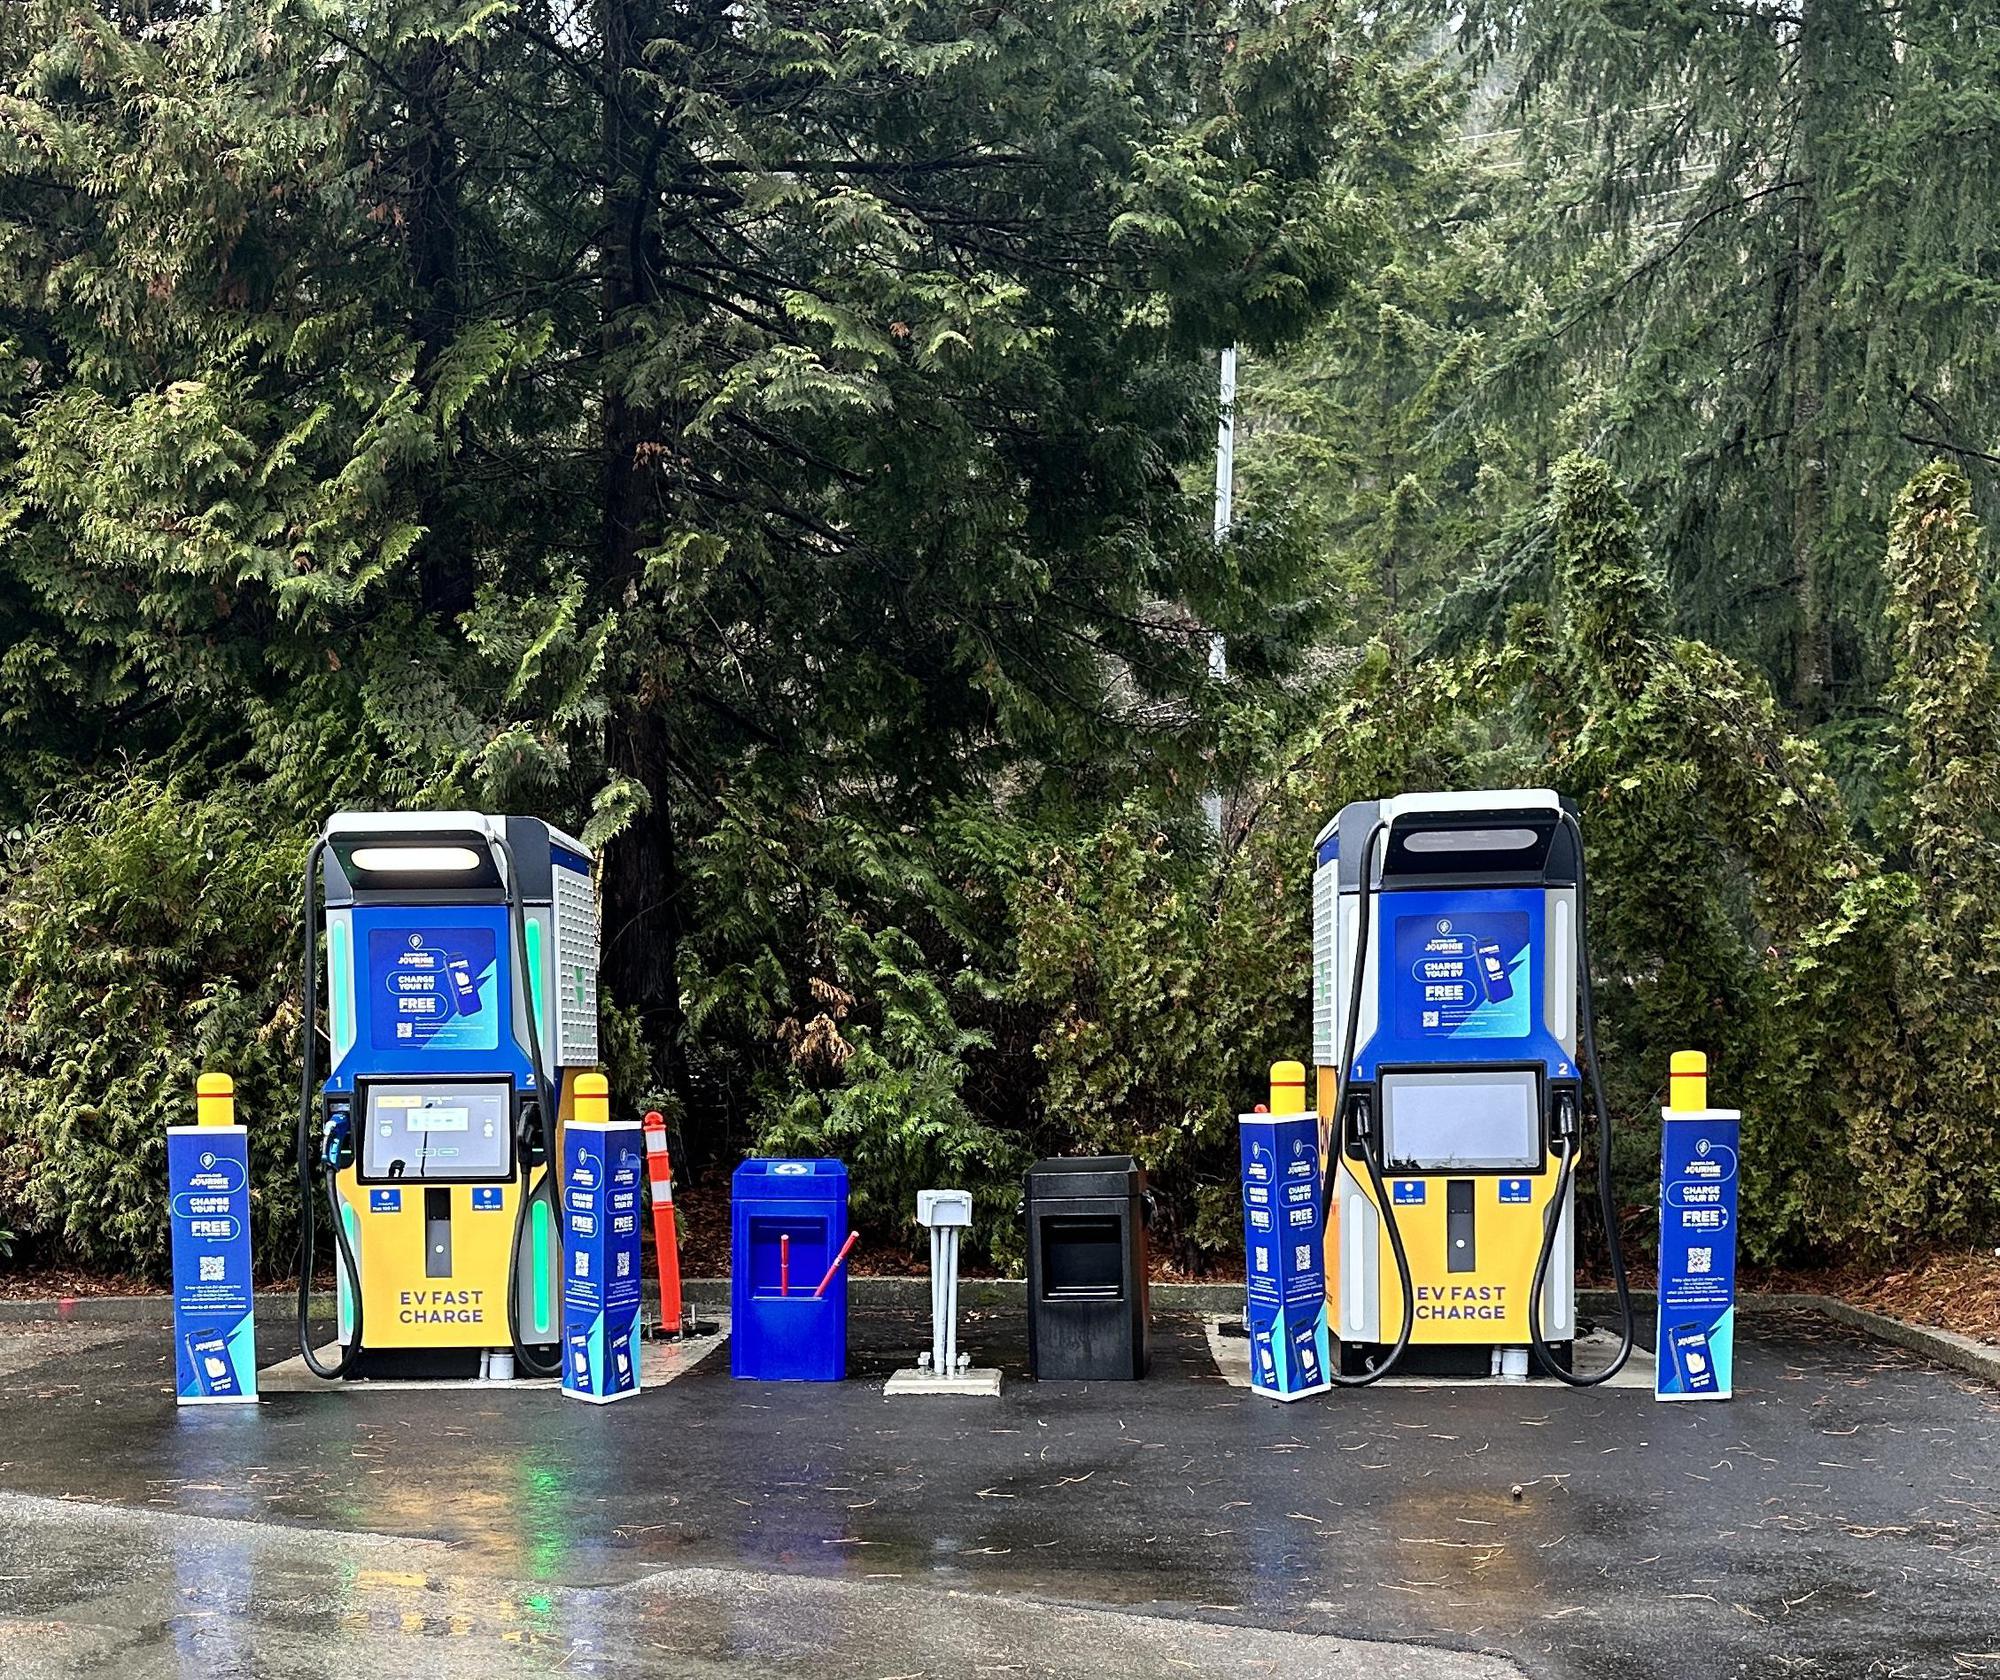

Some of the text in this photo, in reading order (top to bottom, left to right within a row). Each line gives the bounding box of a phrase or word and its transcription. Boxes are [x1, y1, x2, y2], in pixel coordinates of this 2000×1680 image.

[1424, 962, 1463, 970] CHARGE
[1425, 970, 1450, 978] YOUR
[1425, 985, 1463, 997] FREE
[399, 998, 435, 1009] FREE
[1356, 1065, 1363, 1077] 1
[1558, 1063, 1569, 1075] 2
[335, 1076, 342, 1088] 1
[526, 1075, 536, 1085] 2
[1288, 1184, 1311, 1195] CHARGE
[1683, 1186, 1720, 1194] CHARGE
[189, 1197, 230, 1206] CHARGE
[614, 1193, 633, 1201] CHARGE
[1289, 1194, 1304, 1202] YOUR
[1250, 1210, 1269, 1224] FREE
[1289, 1208, 1312, 1223] FREE
[1682, 1210, 1719, 1223] FREE
[191, 1221, 231, 1233] FREE
[572, 1215, 593, 1229] FREE
[614, 1216, 633, 1229] FREE
[401, 1291, 483, 1305] EV FAST
[1417, 1286, 1506, 1300] EV FAST
[400, 1309, 483, 1323] CHARGE
[1416, 1306, 1505, 1319] CHARGE
